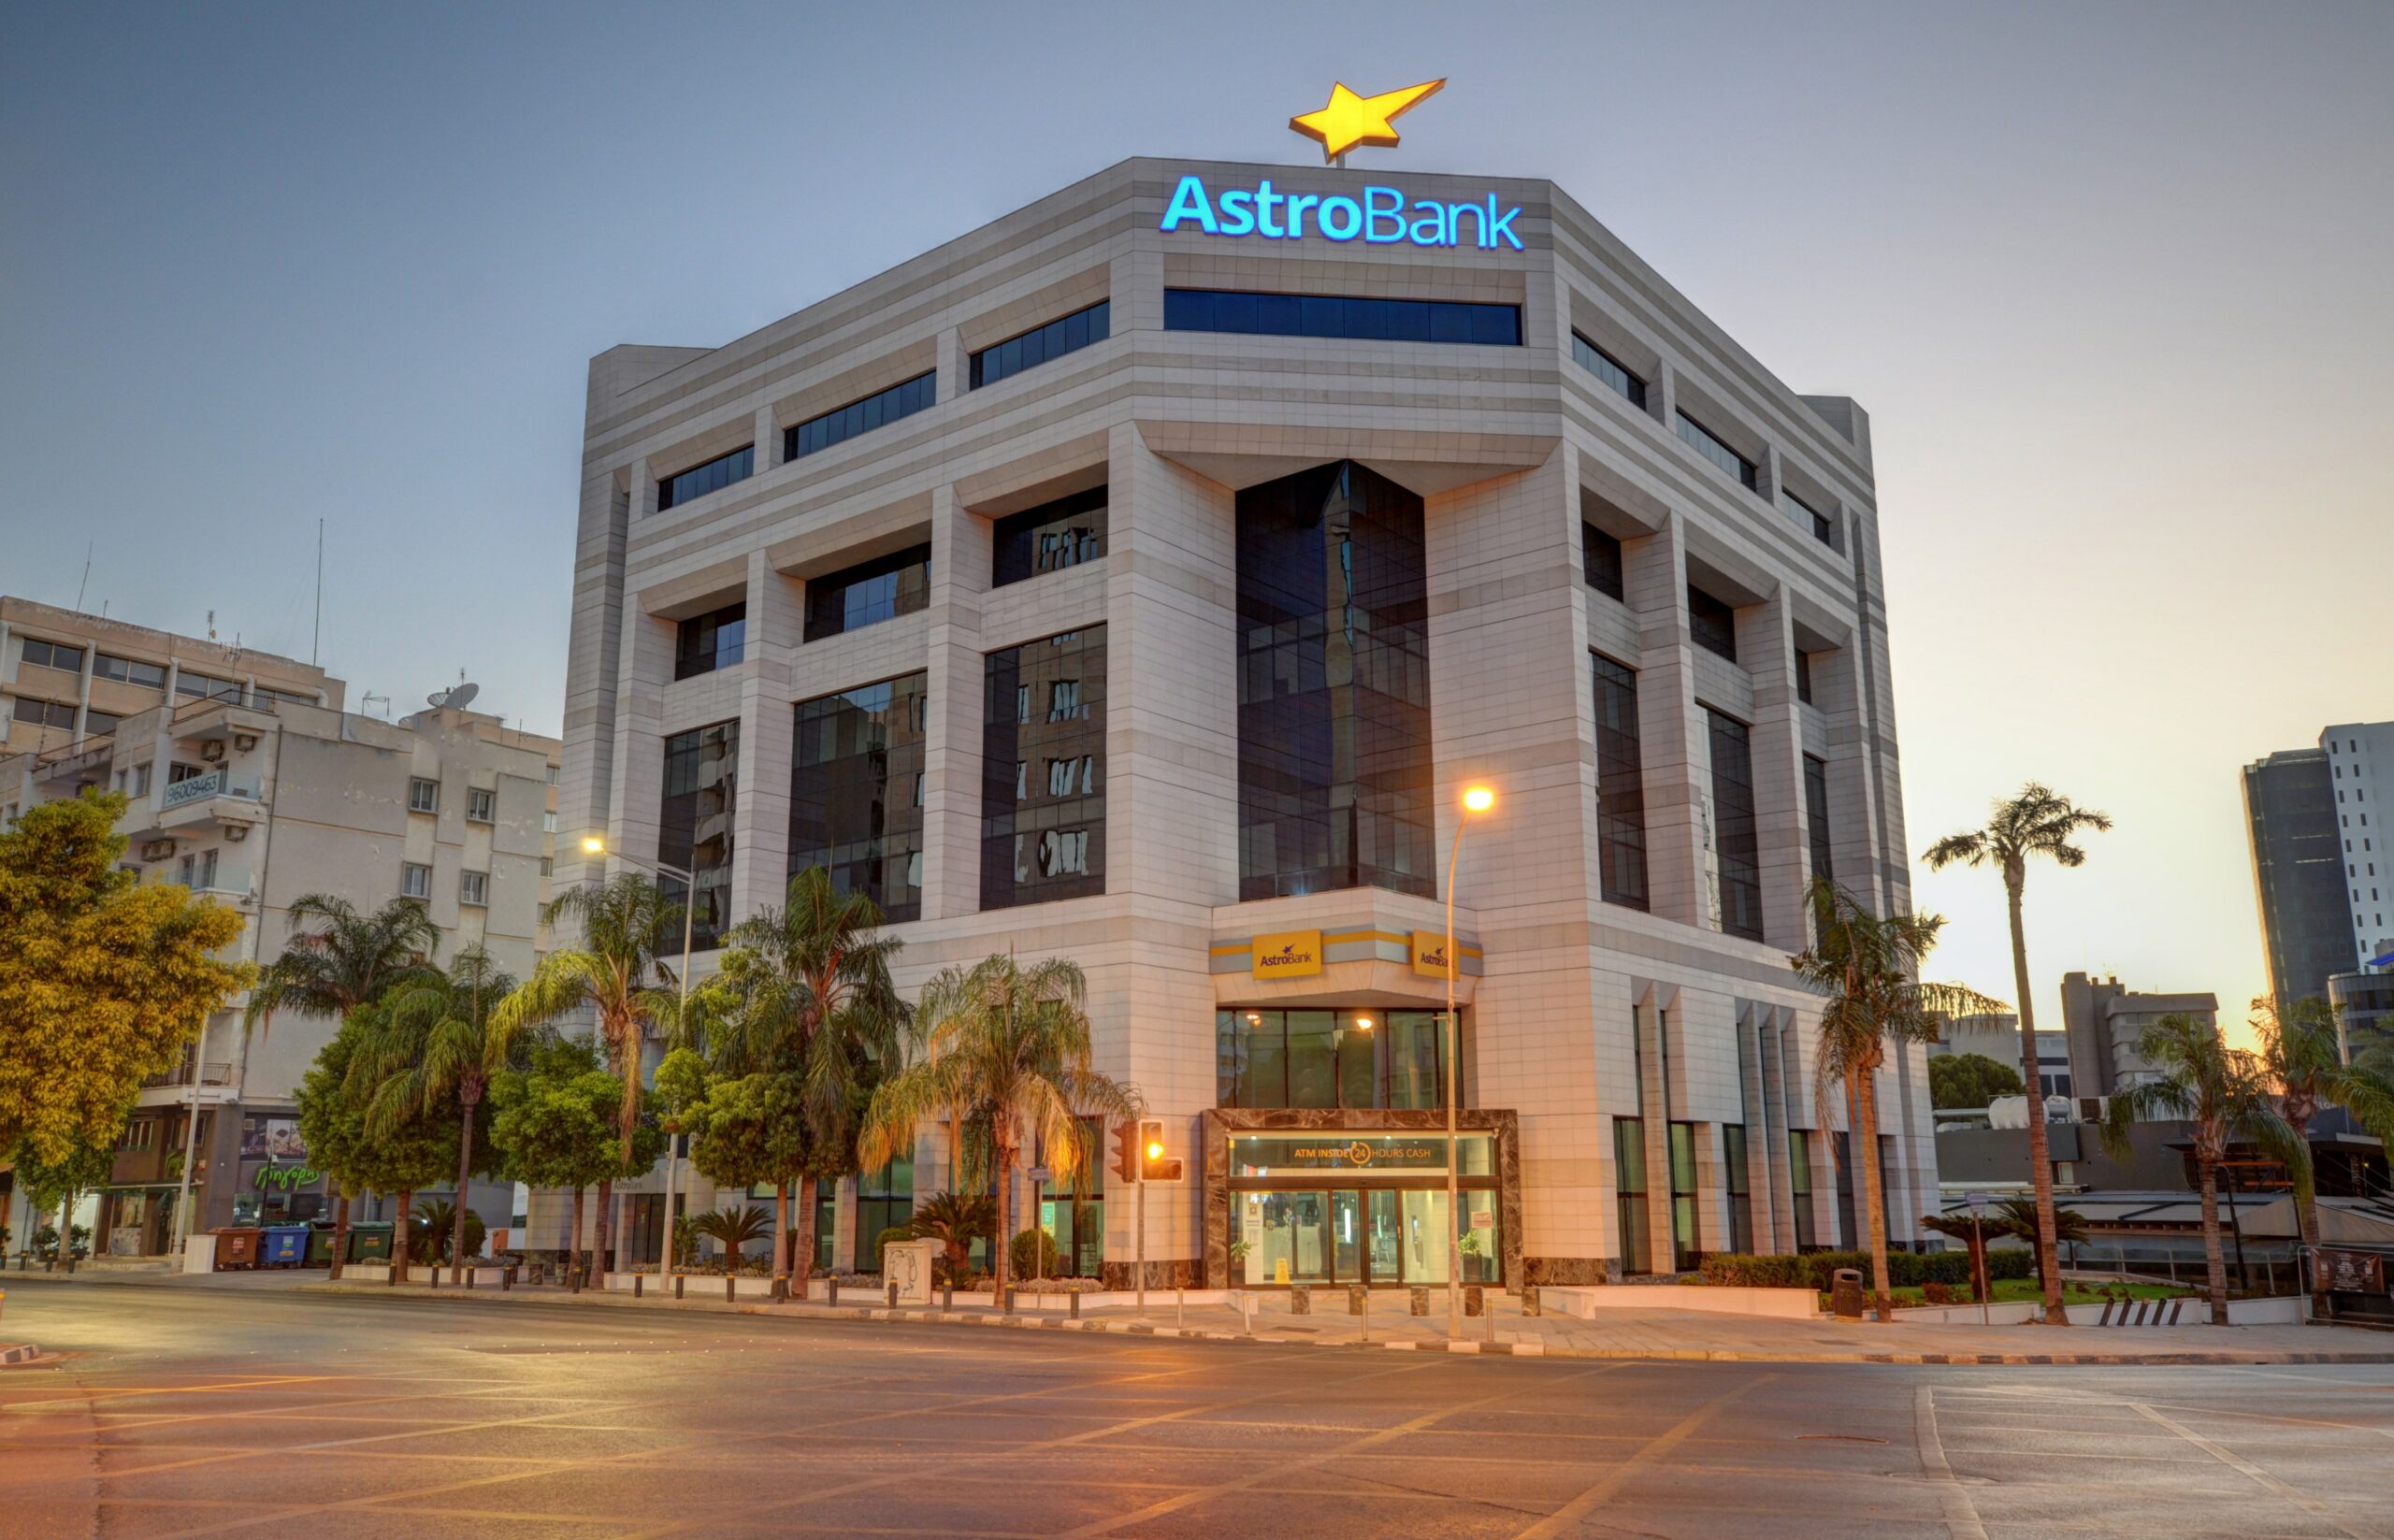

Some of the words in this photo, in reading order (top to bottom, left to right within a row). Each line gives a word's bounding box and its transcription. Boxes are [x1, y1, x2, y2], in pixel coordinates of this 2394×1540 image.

[1160, 175, 1525, 252] AstroBank
[168, 775, 217, 802] 96009463
[1260, 951, 1312, 967] AstroBank
[1294, 1148, 1316, 1158] ATM
[1318, 1148, 1348, 1158] INSIDE
[1354, 1148, 1365, 1159] 24
[1371, 1148, 1405, 1159] HOURS
[1406, 1148, 1431, 1158] CASH
